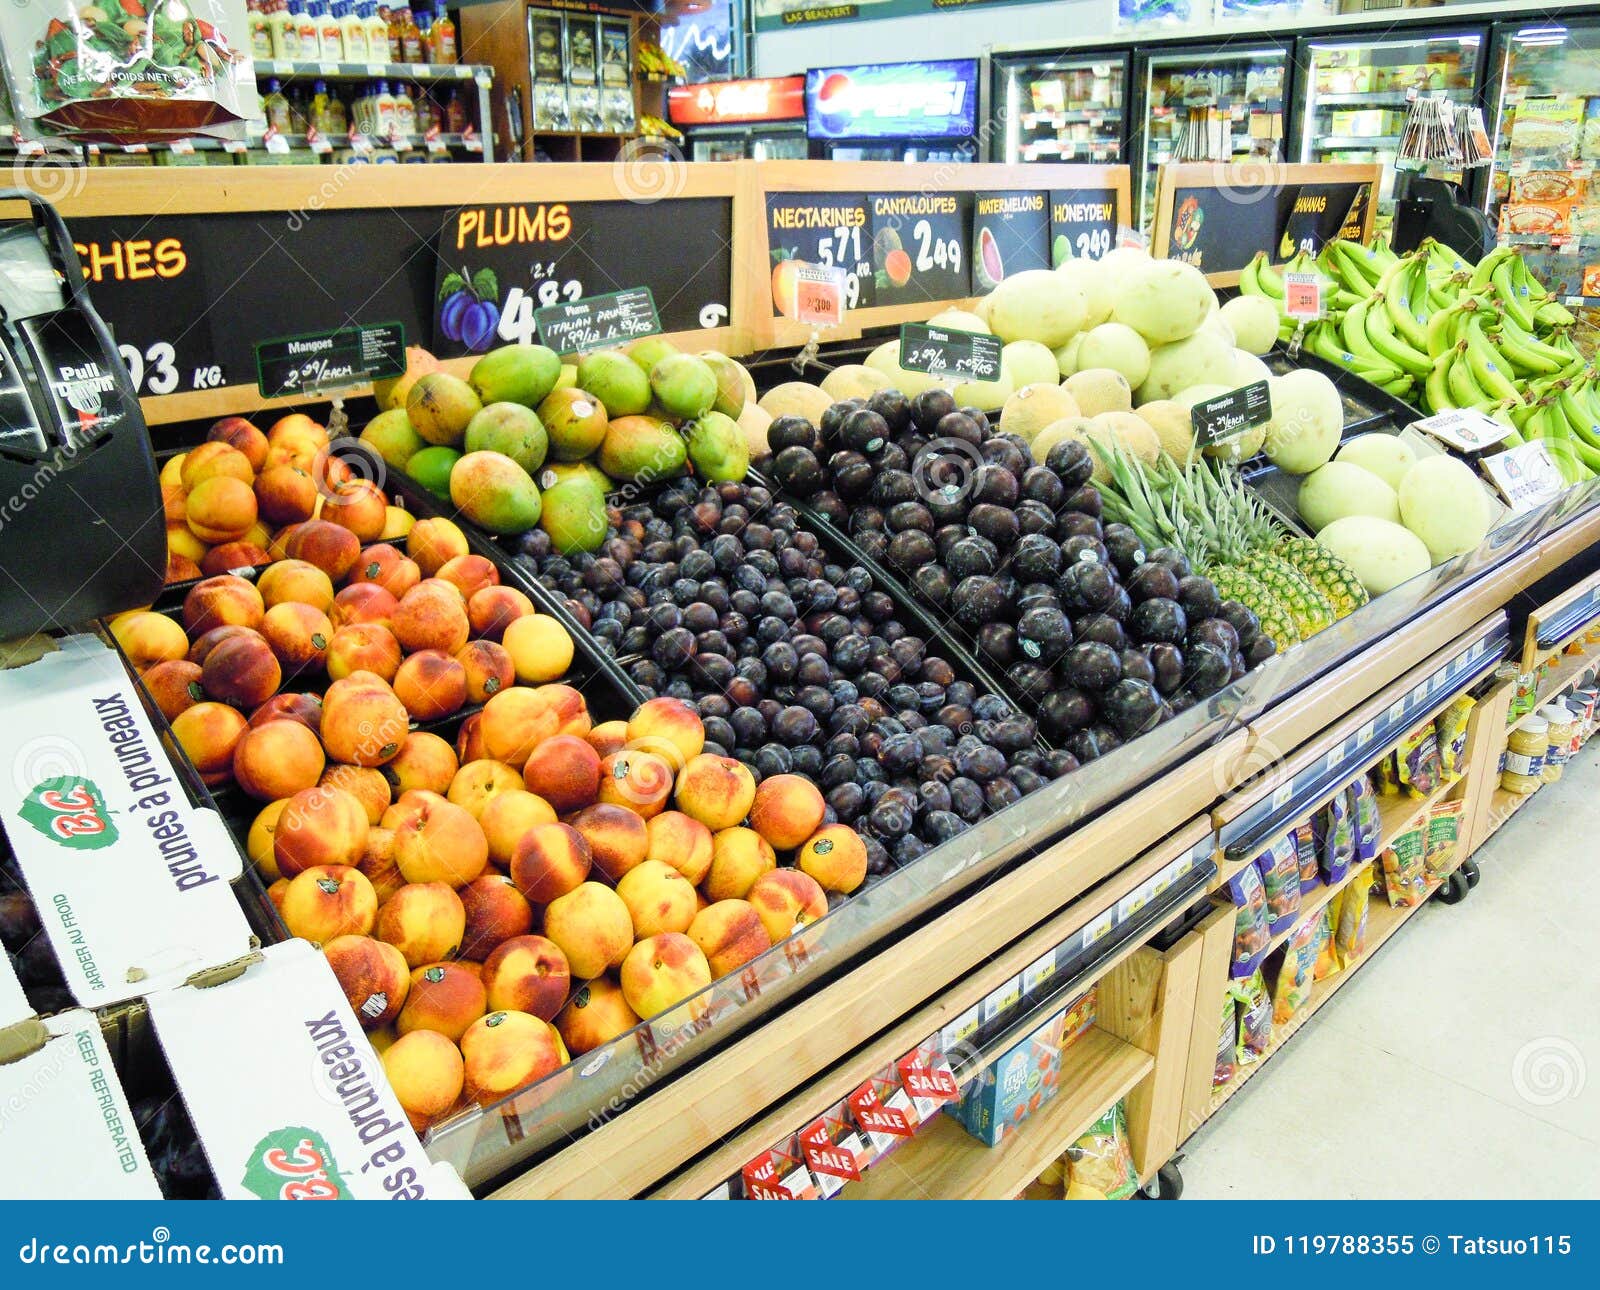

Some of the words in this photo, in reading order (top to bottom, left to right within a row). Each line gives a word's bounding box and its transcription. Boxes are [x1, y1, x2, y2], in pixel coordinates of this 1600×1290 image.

[785, 12, 803, 24] LAC
[806, 5, 852, 21] BEAUVERT
[875, 197, 957, 216] CANTALOUPES
[978, 196, 1044, 215] WATERMELONS
[1054, 203, 1113, 223] HONEYDEW
[456, 203, 572, 250] PLUMS
[773, 207, 866, 229] NECTARINES
[547, 316, 592, 337] ITALIAN
[287, 338, 334, 355] Mangoes
[59, 362, 101, 381] Pull
[193, 365, 226, 389] KG.
[92, 692, 172, 793] pruneaux
[146, 809, 220, 892] prunes
[52, 893, 77, 927] FROID
[70, 928, 85, 947] AU
[77, 947, 105, 991] GARDER
[304, 1009, 404, 1148] pruneaux
[908, 1075, 952, 1093] SALE
[76, 1030, 99, 1067] KEEP
[89, 1070, 139, 1174] REFRIGERATED
[862, 1110, 906, 1129] SALE
[809, 1149, 853, 1172] SALE
